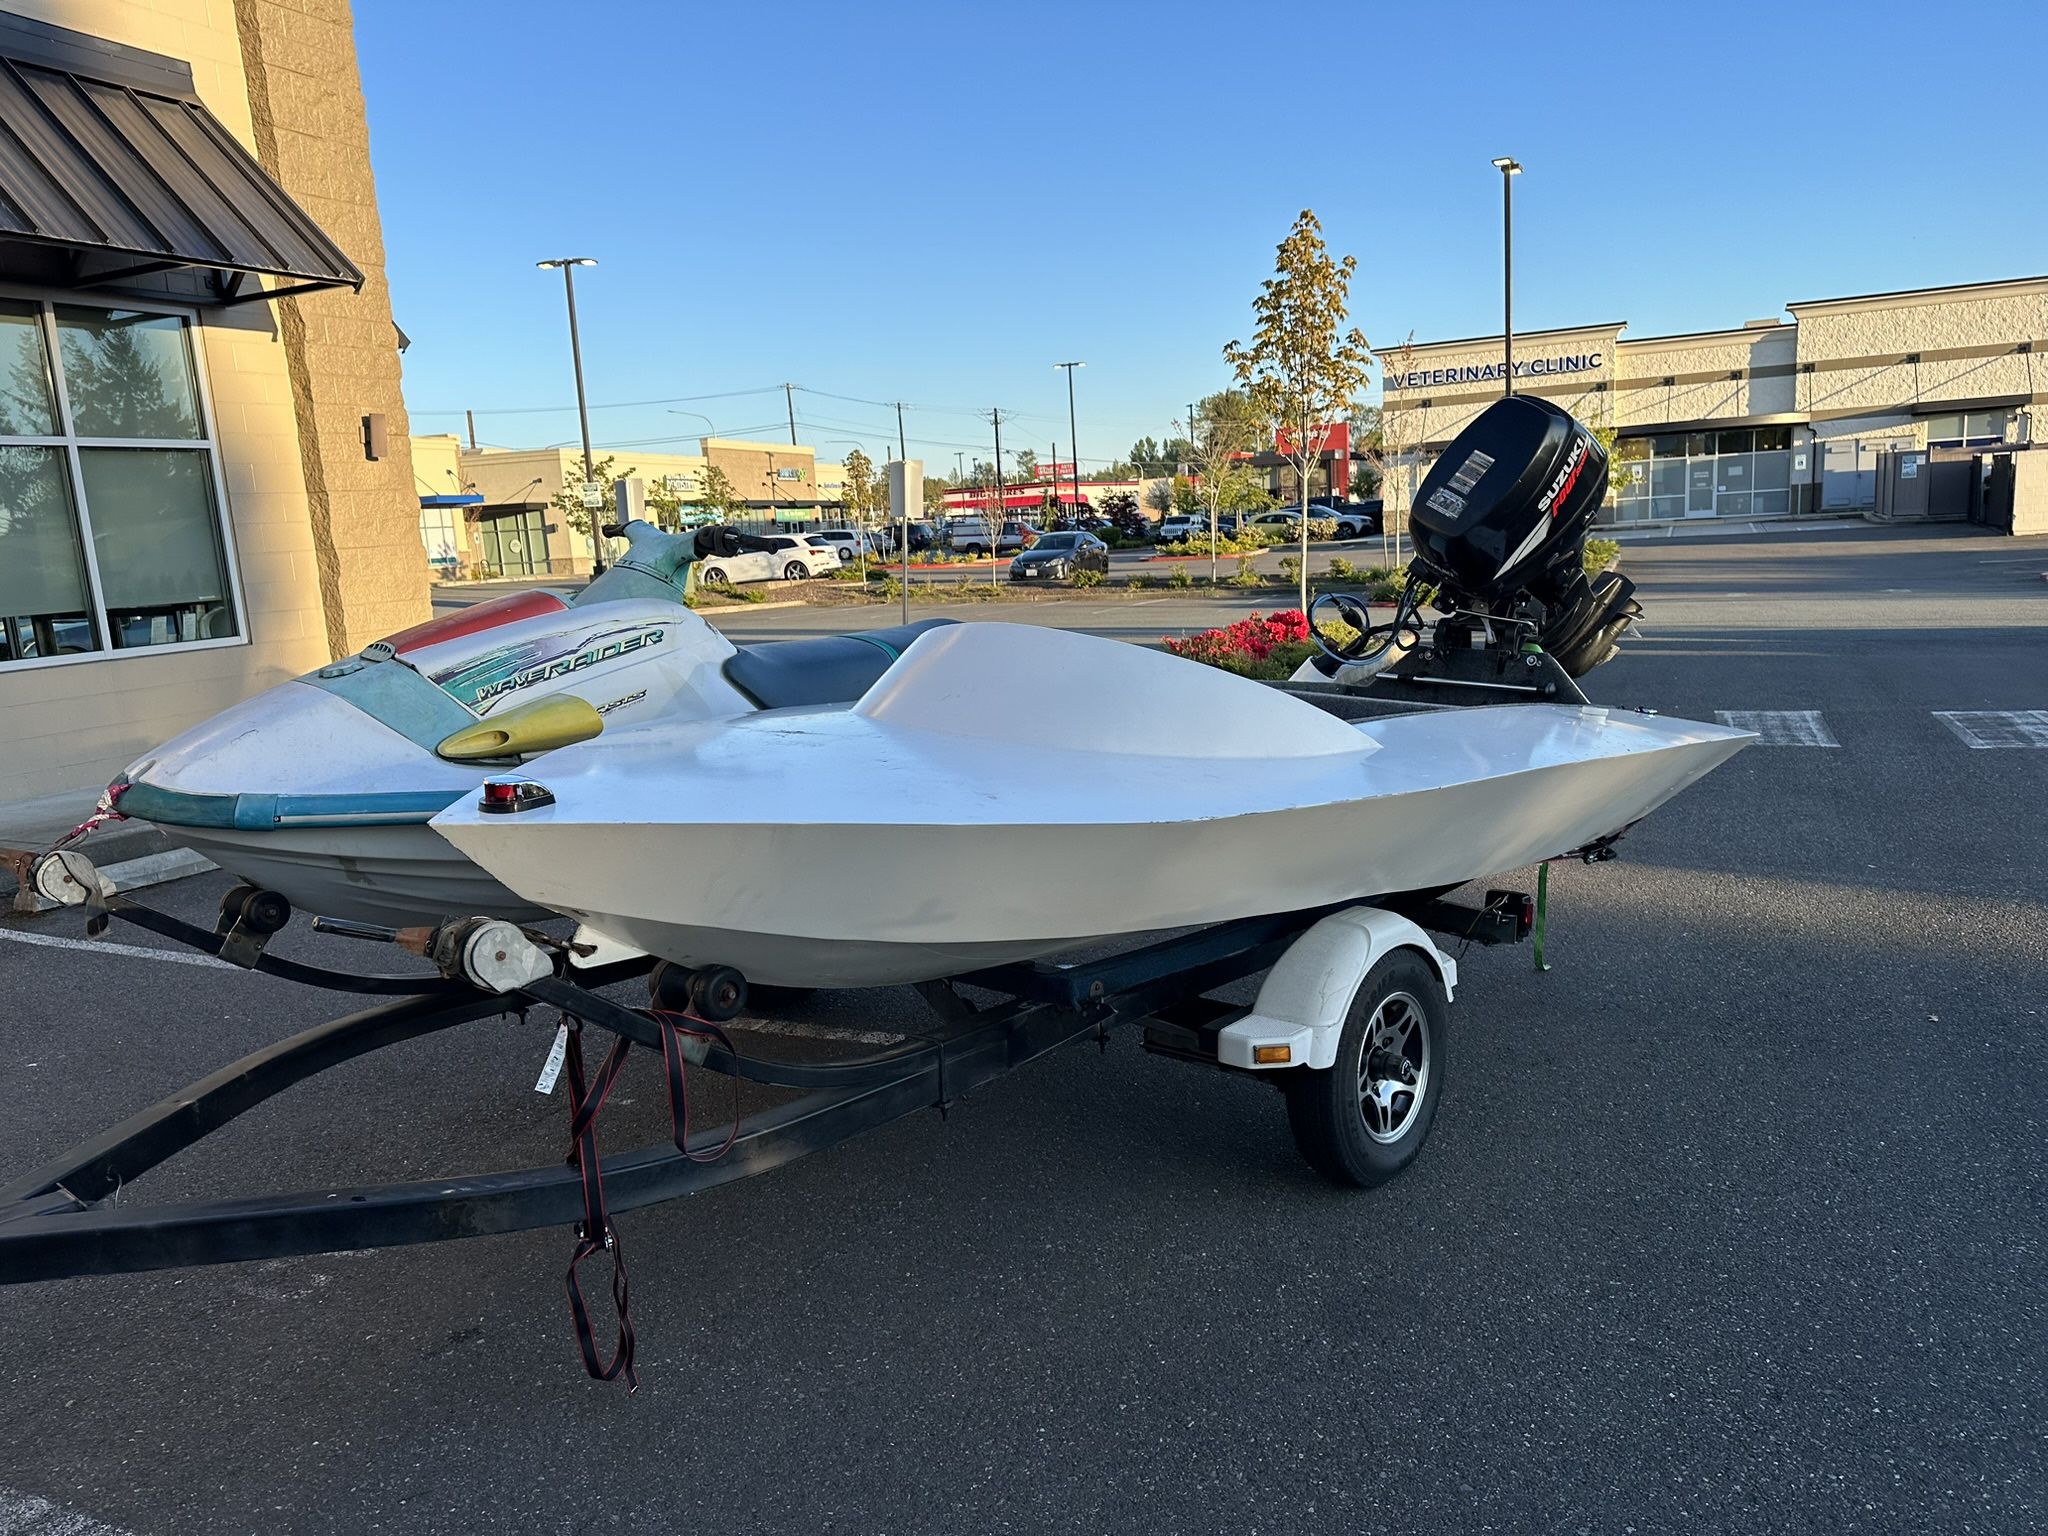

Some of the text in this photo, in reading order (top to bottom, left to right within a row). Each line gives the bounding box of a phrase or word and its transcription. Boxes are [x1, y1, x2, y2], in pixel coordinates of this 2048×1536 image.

[1393, 353, 1603, 388] VETERINARY CLINIC
[1537, 436, 1585, 512] SUZUKI
[476, 629, 665, 702] WAVERAIDER
